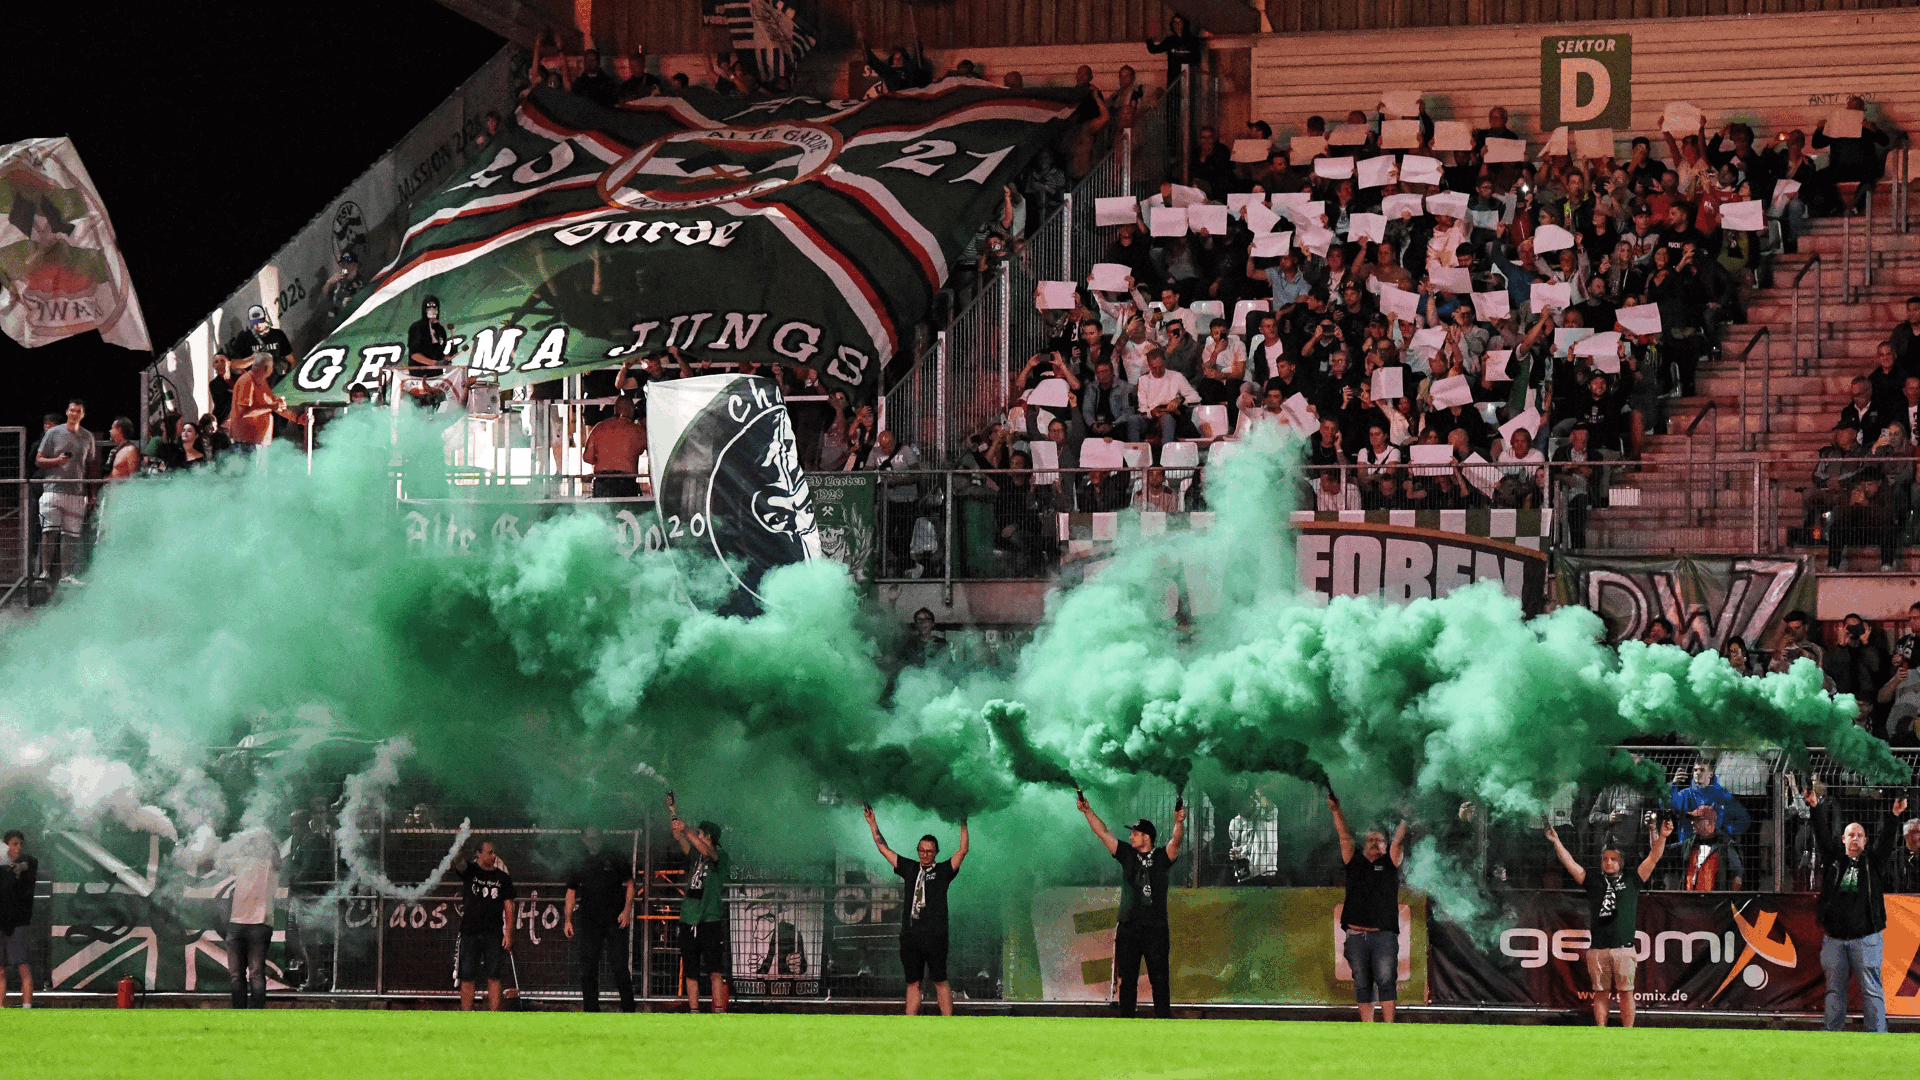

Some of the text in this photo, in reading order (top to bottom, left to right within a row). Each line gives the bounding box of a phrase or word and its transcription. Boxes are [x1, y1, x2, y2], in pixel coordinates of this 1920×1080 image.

[1556, 38, 1617, 54] SEKTOR
[1559, 57, 1612, 123] D
[783, 128, 833, 155] GARDE
[876, 138, 1016, 186] 21
[273, 277, 306, 318] 2028
[607, 312, 870, 387] JUNGS
[804, 475, 867, 487] SV Leoben
[814, 488, 844, 501] 1928
[1296, 530, 1526, 613] EOBEN
[1588, 556, 1801, 653] DW7
[796, 981, 819, 995] UNS
